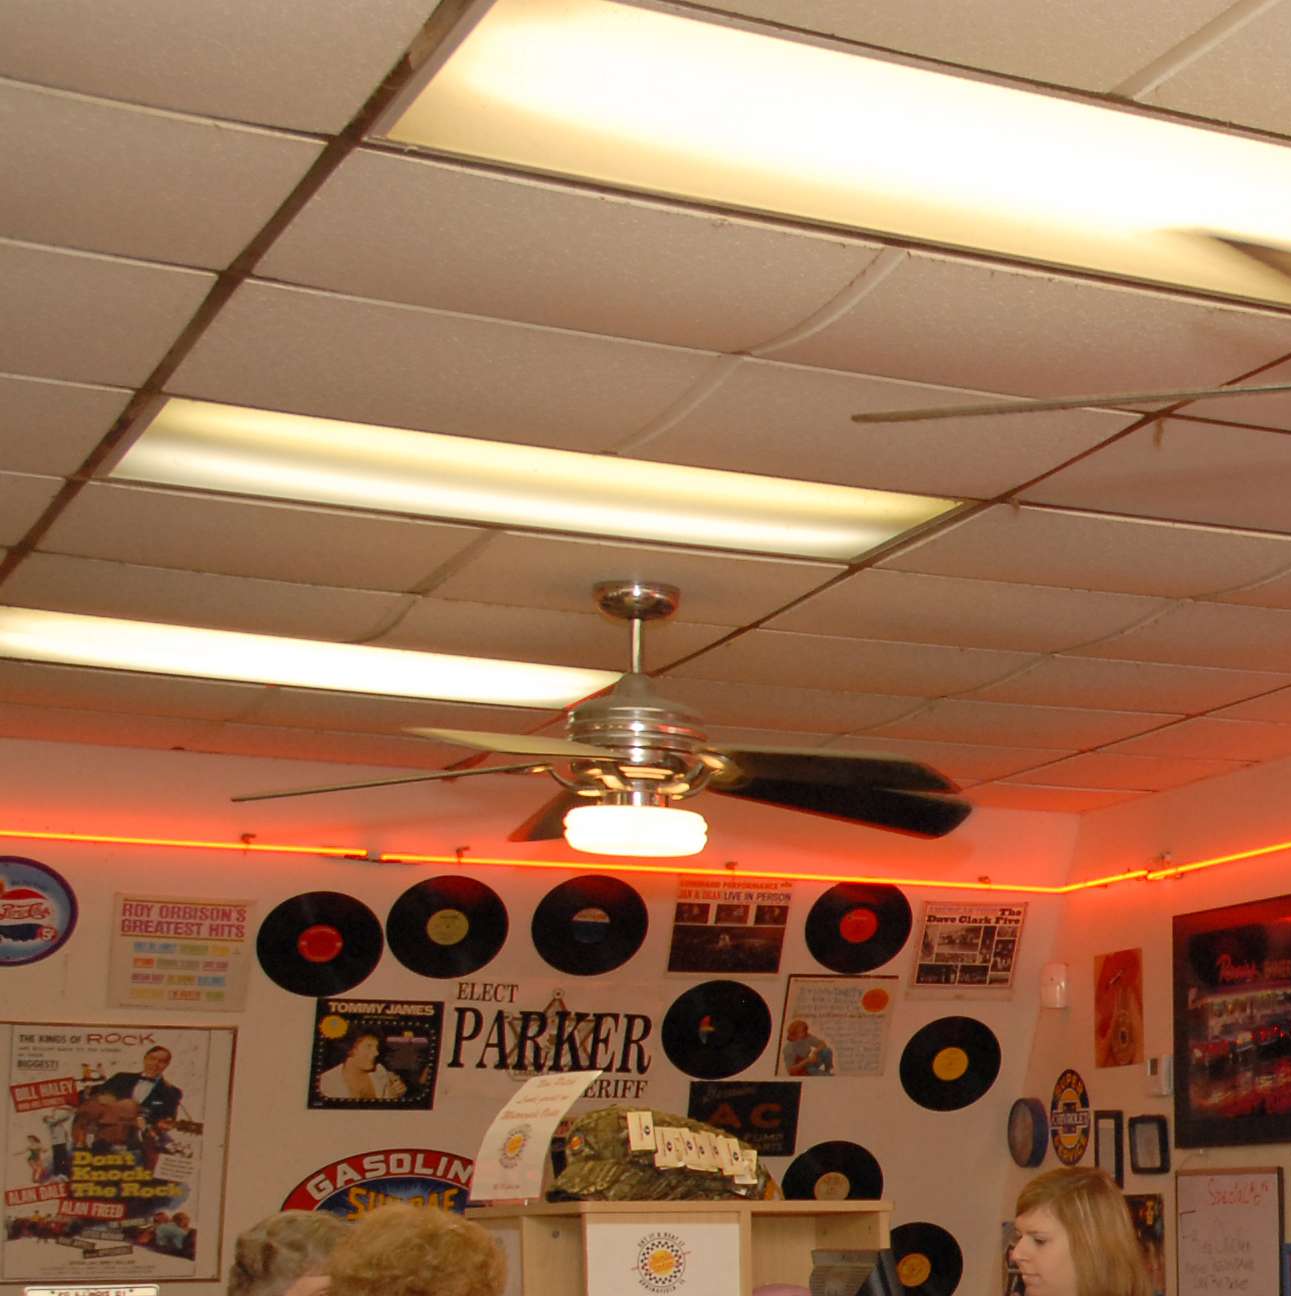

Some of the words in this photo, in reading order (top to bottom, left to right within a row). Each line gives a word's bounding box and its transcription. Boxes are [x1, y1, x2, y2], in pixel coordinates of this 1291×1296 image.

[723, 891, 740, 901] LIVE
[744, 892, 754, 901] IN
[756, 891, 791, 902] PERSON
[122, 902, 154, 918] ROY
[159, 905, 248, 923] ORBISON'S
[926, 915, 957, 924] Dave
[958, 915, 992, 925] Clark
[994, 916, 1021, 925] Five
[1000, 908, 1022, 917] The
[121, 918, 204, 937] GREATEST
[208, 922, 245, 939] HITS
[456, 982, 520, 1004] ELECT
[328, 1001, 386, 1015] TOMMY
[385, 1003, 435, 1017] JAMES
[86, 1032, 156, 1046] ROCK
[447, 1006, 654, 1076] PARKER
[580, 1078, 648, 1099] ERIFF
[72, 1151, 136, 1166] Don't
[72, 1166, 154, 1182] Knock
[305, 1153, 474, 1200] GASOLIN
[71, 1182, 119, 1198] The
[120, 1182, 184, 1198] Rock
[60, 1200, 90, 1217] ALAN
